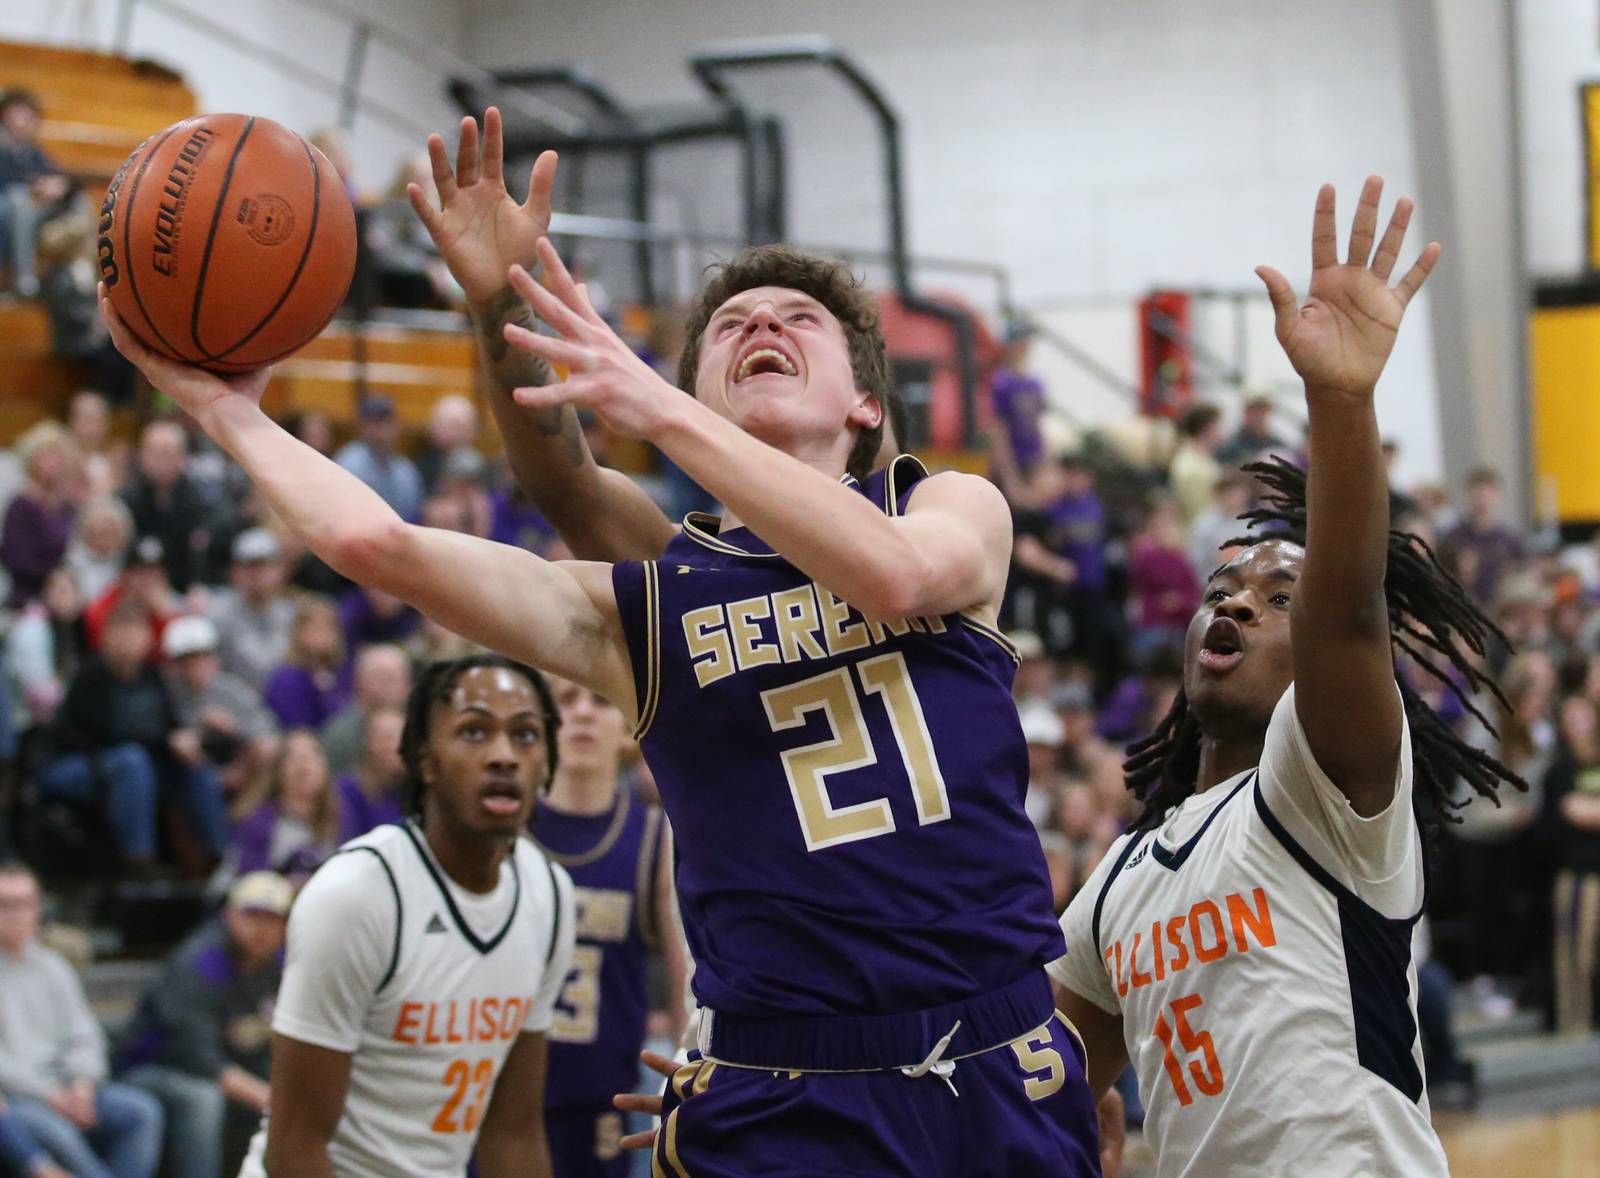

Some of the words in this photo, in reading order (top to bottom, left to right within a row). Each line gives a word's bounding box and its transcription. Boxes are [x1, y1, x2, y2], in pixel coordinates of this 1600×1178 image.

[152, 127, 216, 277] EVOLUTION
[682, 580, 947, 688] SERE
[760, 651, 951, 852] 21
[431, 1058, 494, 1134] 23
[1011, 1025, 1066, 1102] S
[1153, 993, 1224, 1107] 15
